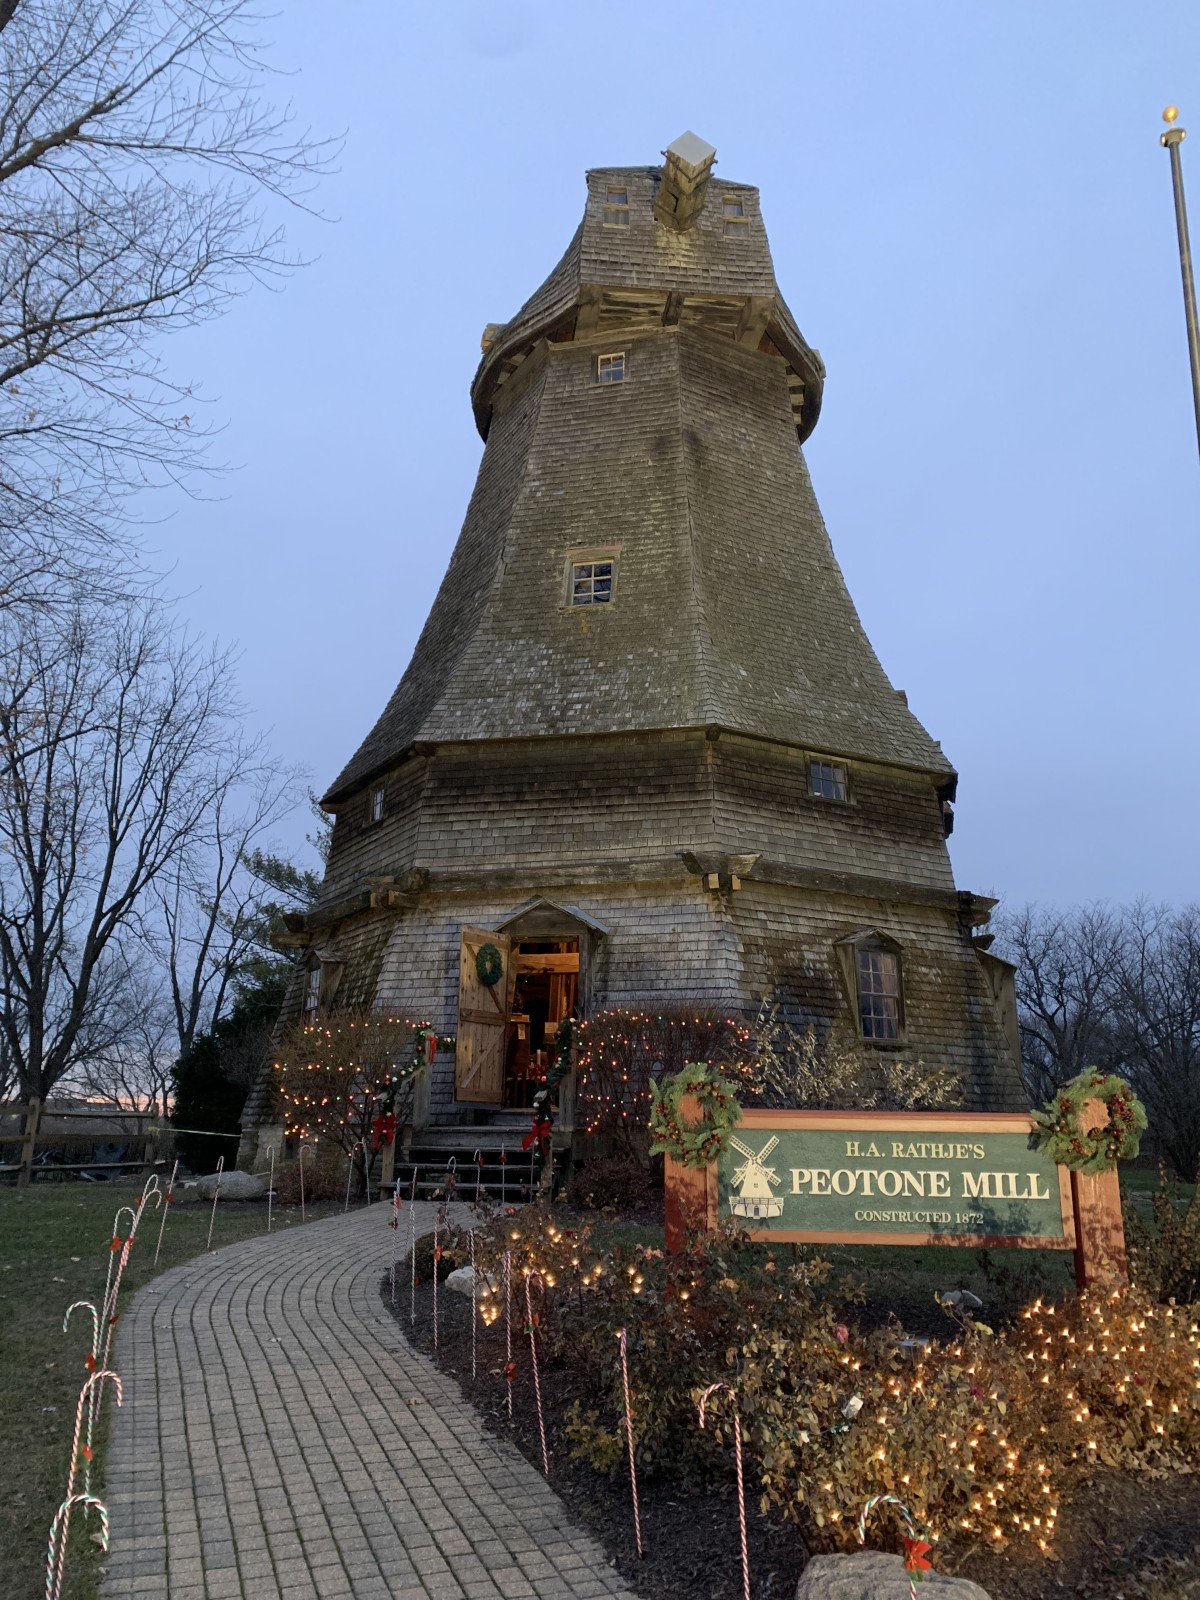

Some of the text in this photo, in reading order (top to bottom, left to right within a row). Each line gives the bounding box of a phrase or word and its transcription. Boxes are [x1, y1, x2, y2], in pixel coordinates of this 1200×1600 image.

[846, 1141, 985, 1159] H.A. RATHJE'S
[789, 1168, 1050, 1200] PEOTONE MILL
[854, 1210, 984, 1225] CONSTRUCTED 1872
